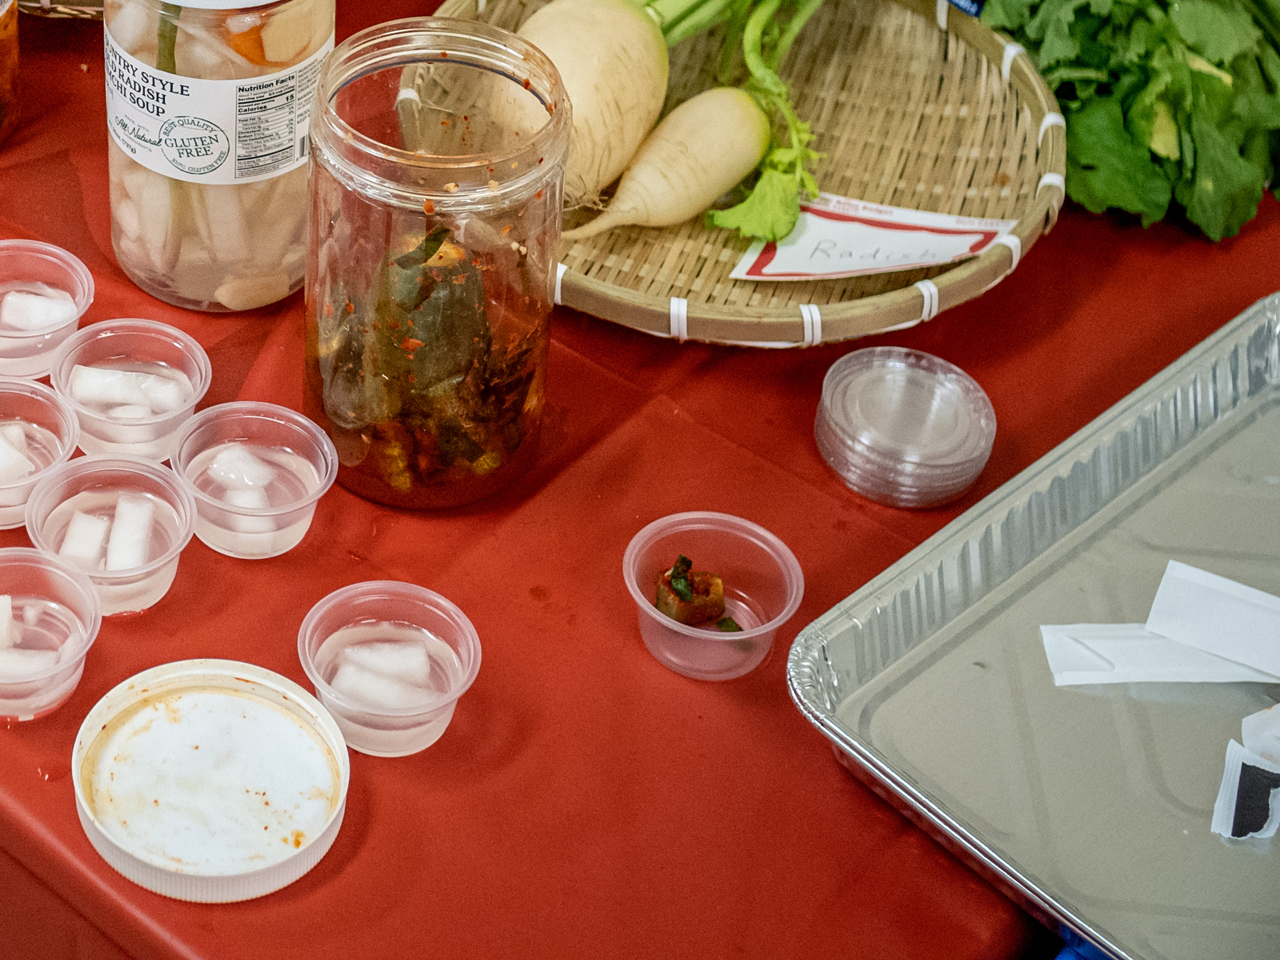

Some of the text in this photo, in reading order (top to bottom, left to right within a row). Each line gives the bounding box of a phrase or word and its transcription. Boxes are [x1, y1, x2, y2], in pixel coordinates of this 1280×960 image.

[118, 68, 167, 105] RADISH
[141, 71, 190, 97] STYLE
[238, 82, 274, 93] Nutrition
[275, 75, 295, 86] Facts
[129, 92, 166, 117] SOUP
[285, 93, 295, 102] 15
[238, 105, 267, 113] Calories
[127, 127, 163, 147] Natural
[163, 121, 177, 137] BEST
[177, 119, 217, 133] QUALITY
[164, 134, 219, 148] GLUTEN
[177, 146, 214, 158] FREE
[187, 162, 216, 173] GLUTEN
[213, 150, 227, 165] FREE
